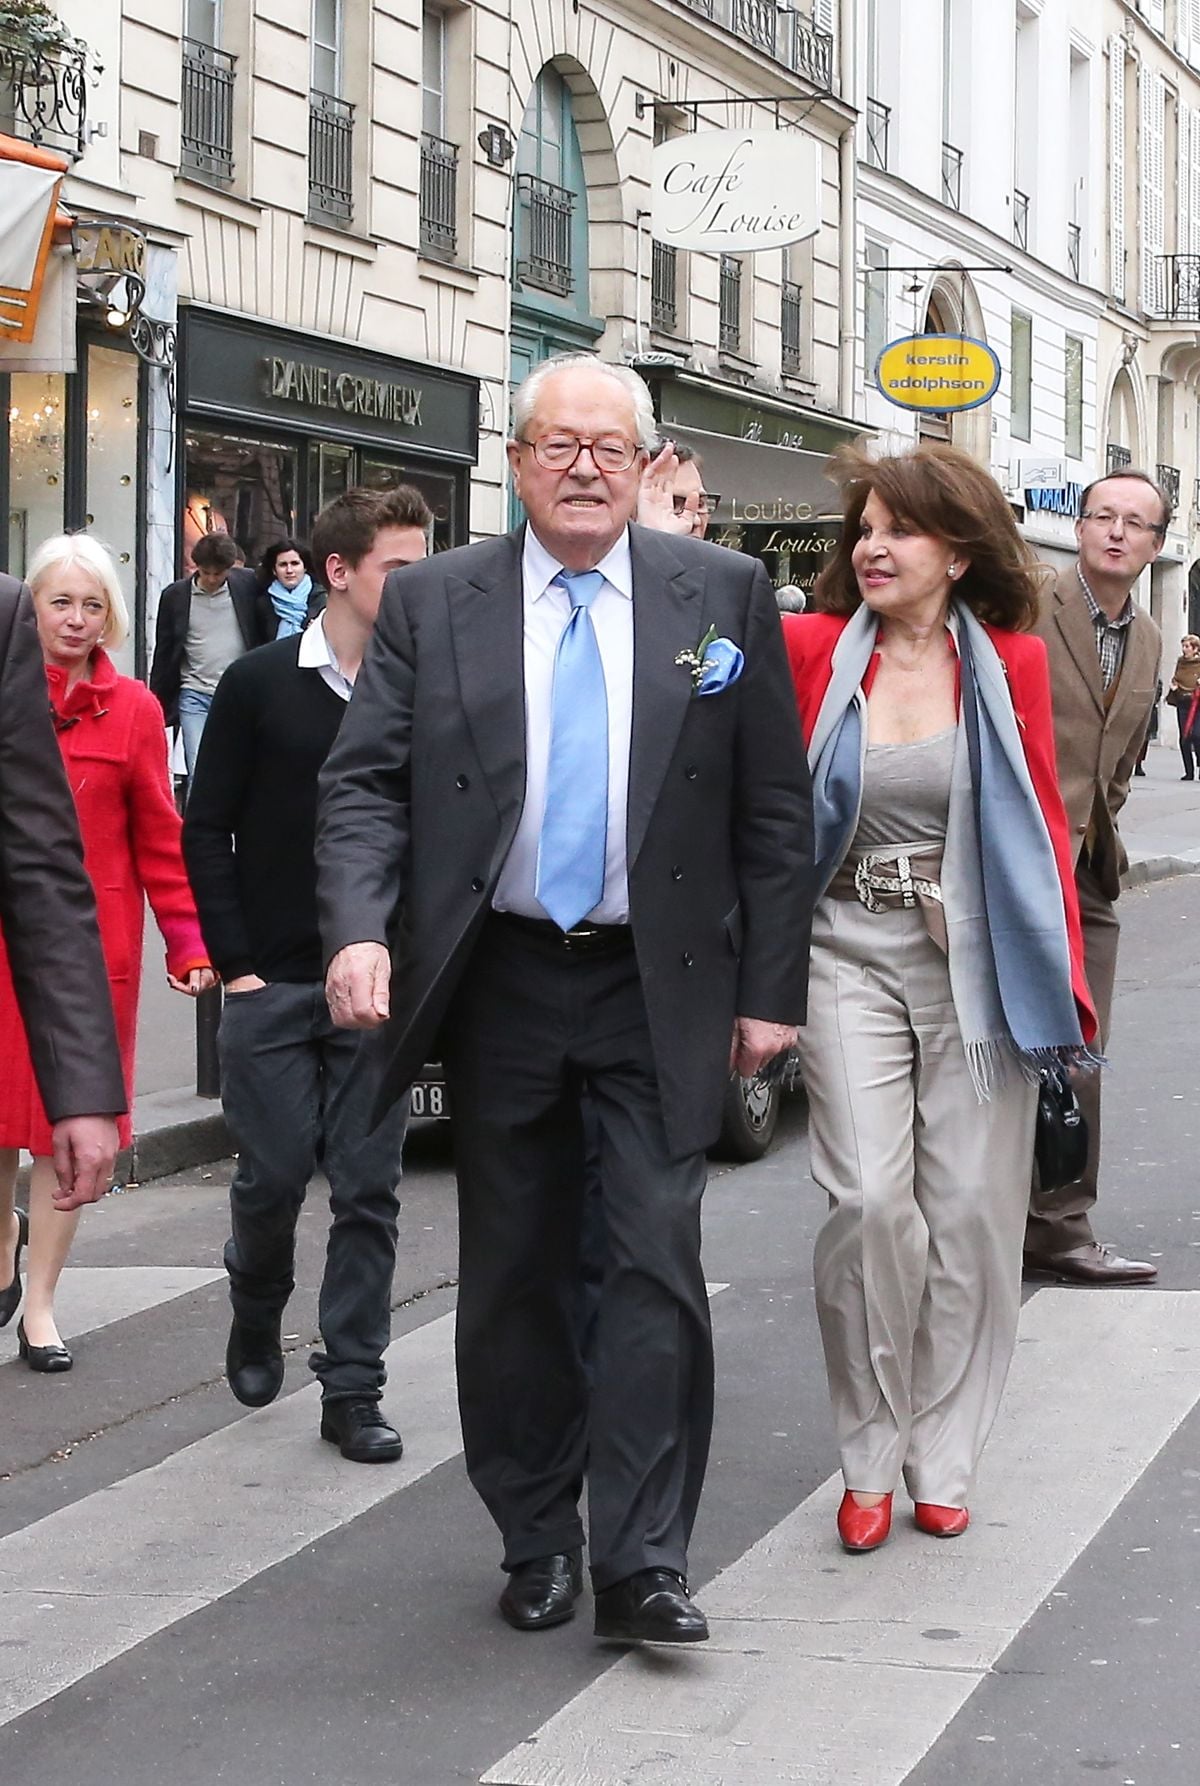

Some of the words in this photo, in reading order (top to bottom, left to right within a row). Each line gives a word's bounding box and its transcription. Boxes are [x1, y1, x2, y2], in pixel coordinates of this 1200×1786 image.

[664, 139, 753, 234] Café
[700, 201, 806, 234] Louise
[906, 354, 969, 366] kerstin
[272, 356, 338, 409] DANIEL
[889, 376, 985, 392] adolphson
[731, 498, 812, 520] Louise
[1040, 482, 1083, 517] BARCLAY
[761, 530, 837, 553] Louise
